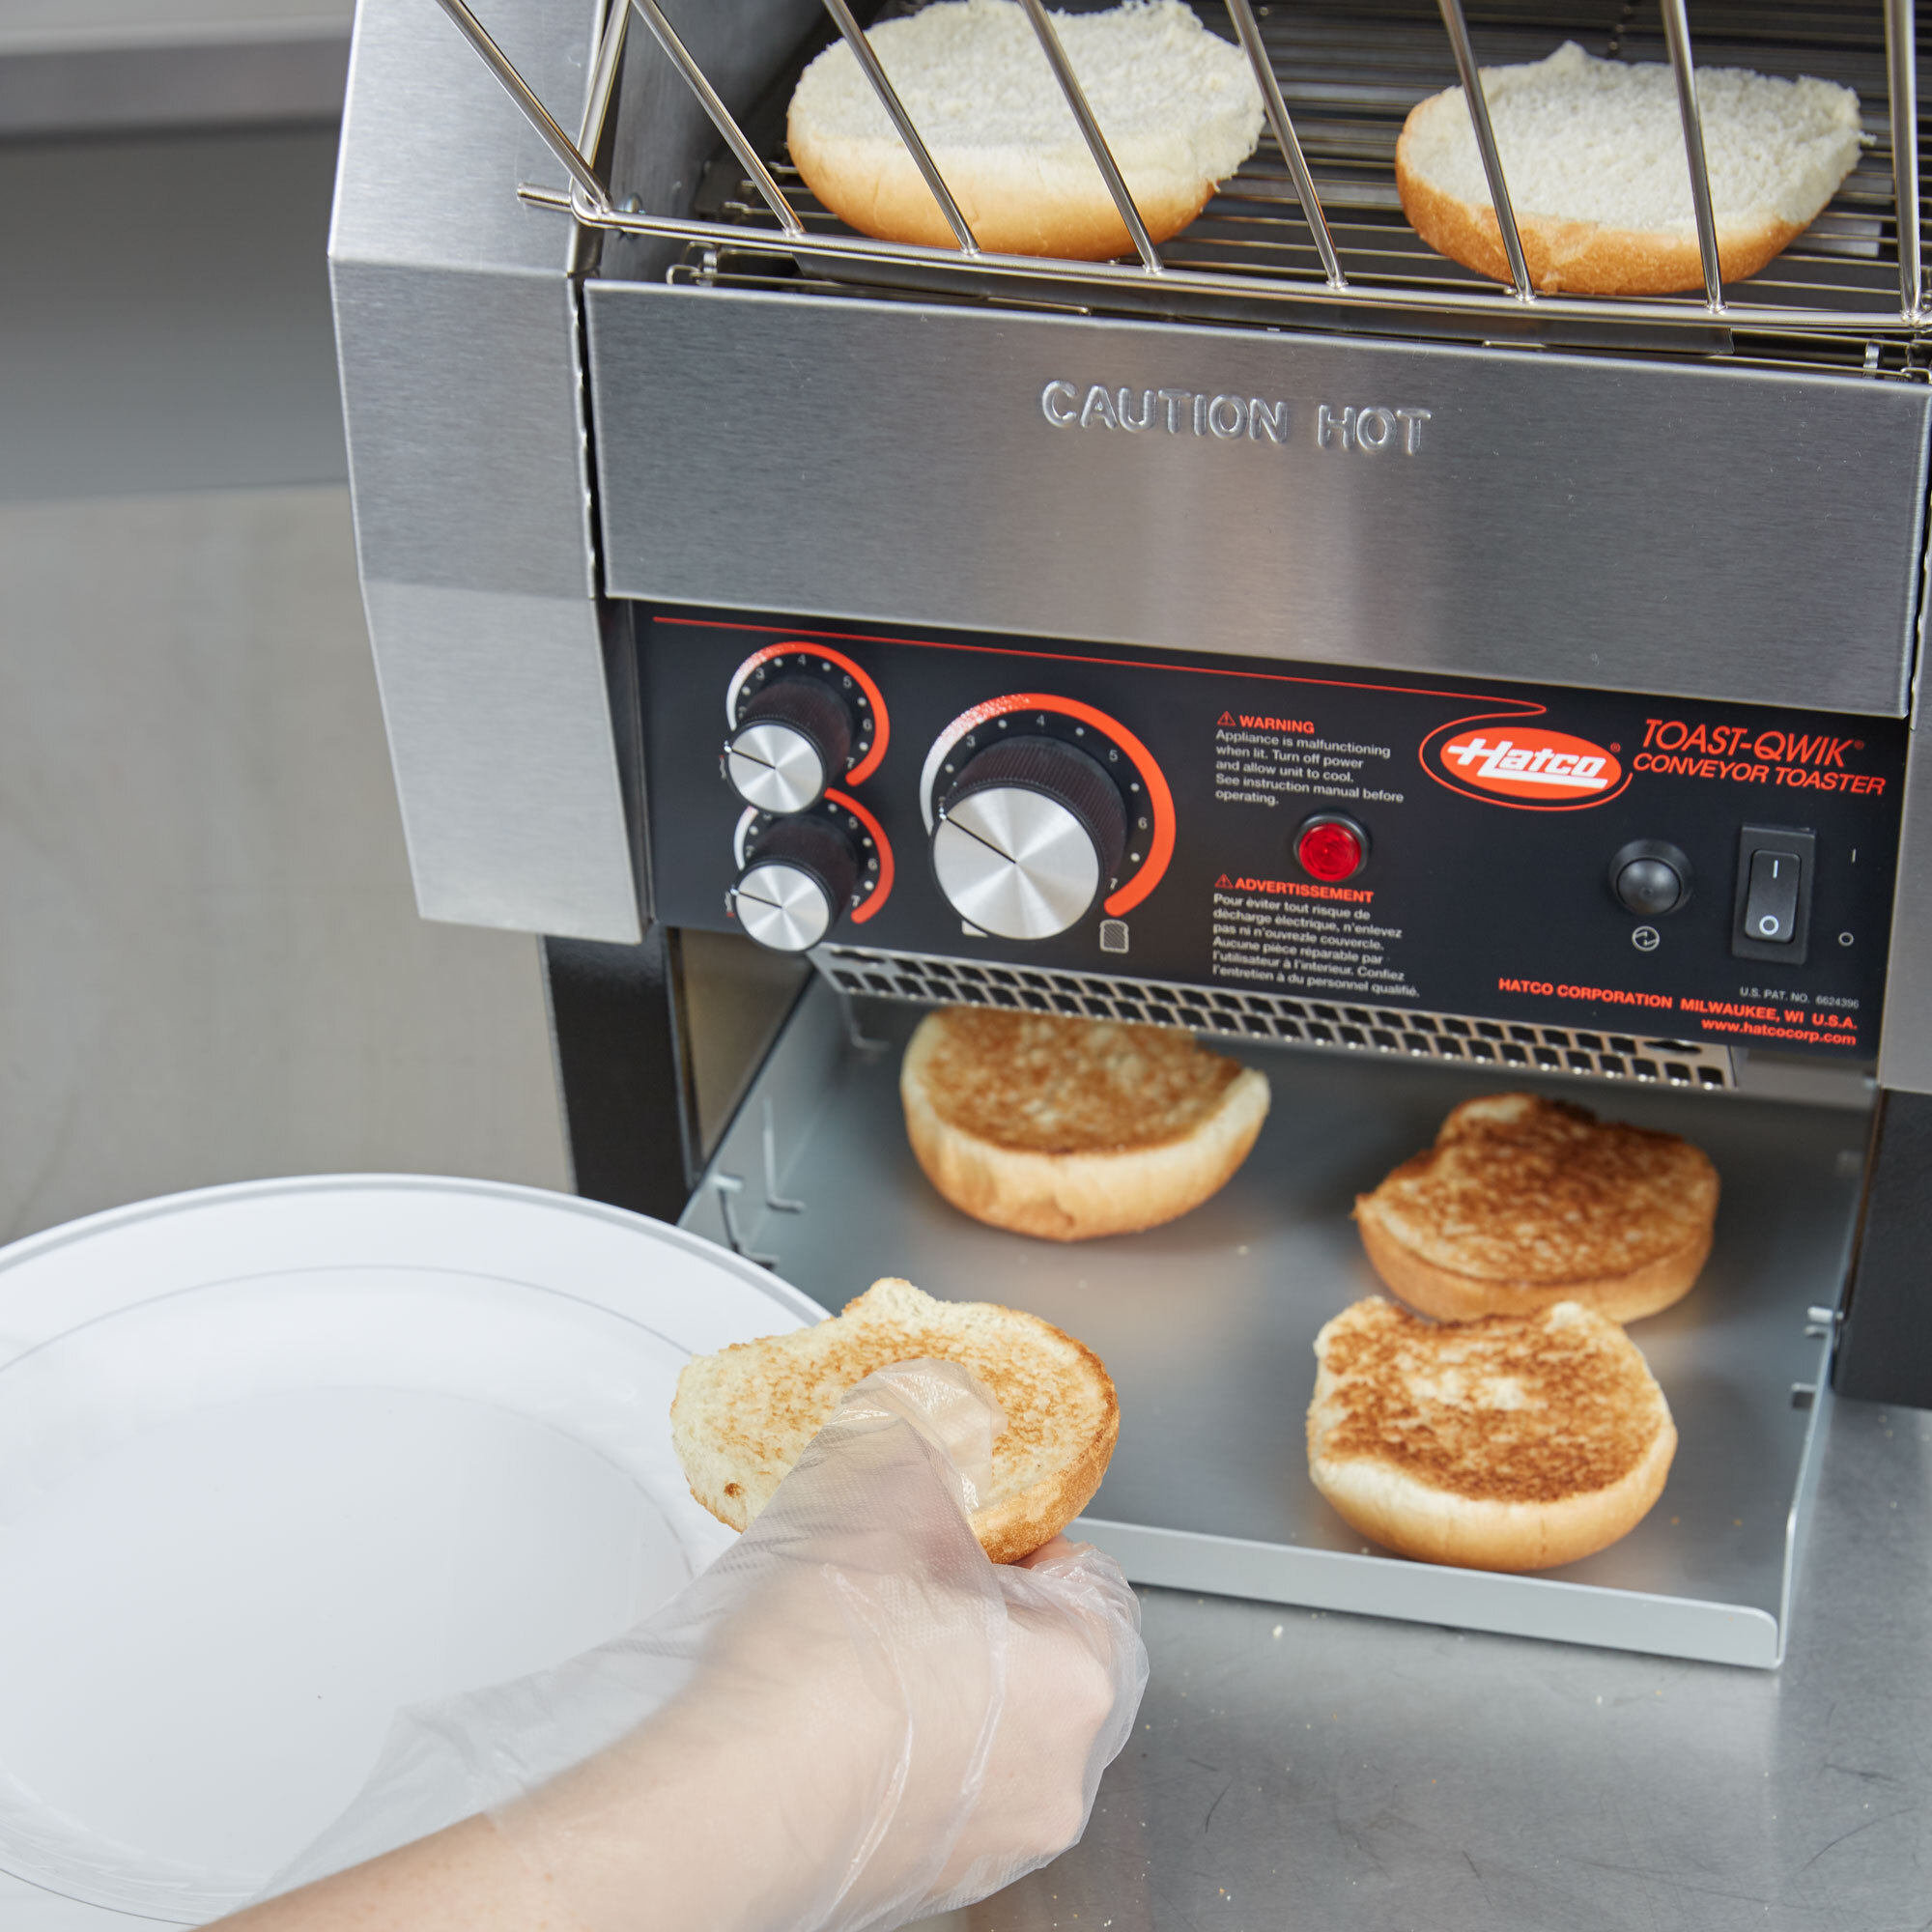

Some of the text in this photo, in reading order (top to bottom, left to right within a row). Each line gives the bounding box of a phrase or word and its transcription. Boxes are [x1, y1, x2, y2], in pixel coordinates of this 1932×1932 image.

[1041, 380, 1432, 455] CAUTION HOT
[1239, 715, 1315, 734] WARNING
[1215, 729, 1391, 759] Appliance is malfunctioning
[1215, 760, 1354, 782] and allow unit to cool.
[1216, 746, 1364, 770] when lit. Turn off power
[1447, 738, 1607, 789] Hatco
[1215, 774, 1405, 803] See instruction manual before
[1633, 753, 1886, 797] CONVEYOR TOASTER
[1215, 790, 1279, 807] operating.
[1234, 877, 1375, 904] ADVERTISSEMENT
[1213, 893, 1243, 906] Pour
[1284, 900, 1309, 914] tout
[1312, 903, 1350, 920] risque
[1353, 908, 1371, 921] de
[1213, 923, 1236, 936] pas
[1239, 925, 1251, 936] ni
[1213, 935, 1261, 952] Aucune
[1361, 954, 1383, 966] par
[1276, 972, 1286, 983] à
[1288, 975, 1304, 986] du
[1307, 977, 1369, 992] personnel
[1283, 958, 1292, 970] à
[1357, 966, 1406, 982] Confiez
[1498, 978, 1858, 1030] HATCO CORPORATION MILWAUKEE, WI U.S.A.
[1740, 985, 1761, 1000] U.S.
[1701, 1017, 1857, 1046] www.hatcocorp.com
